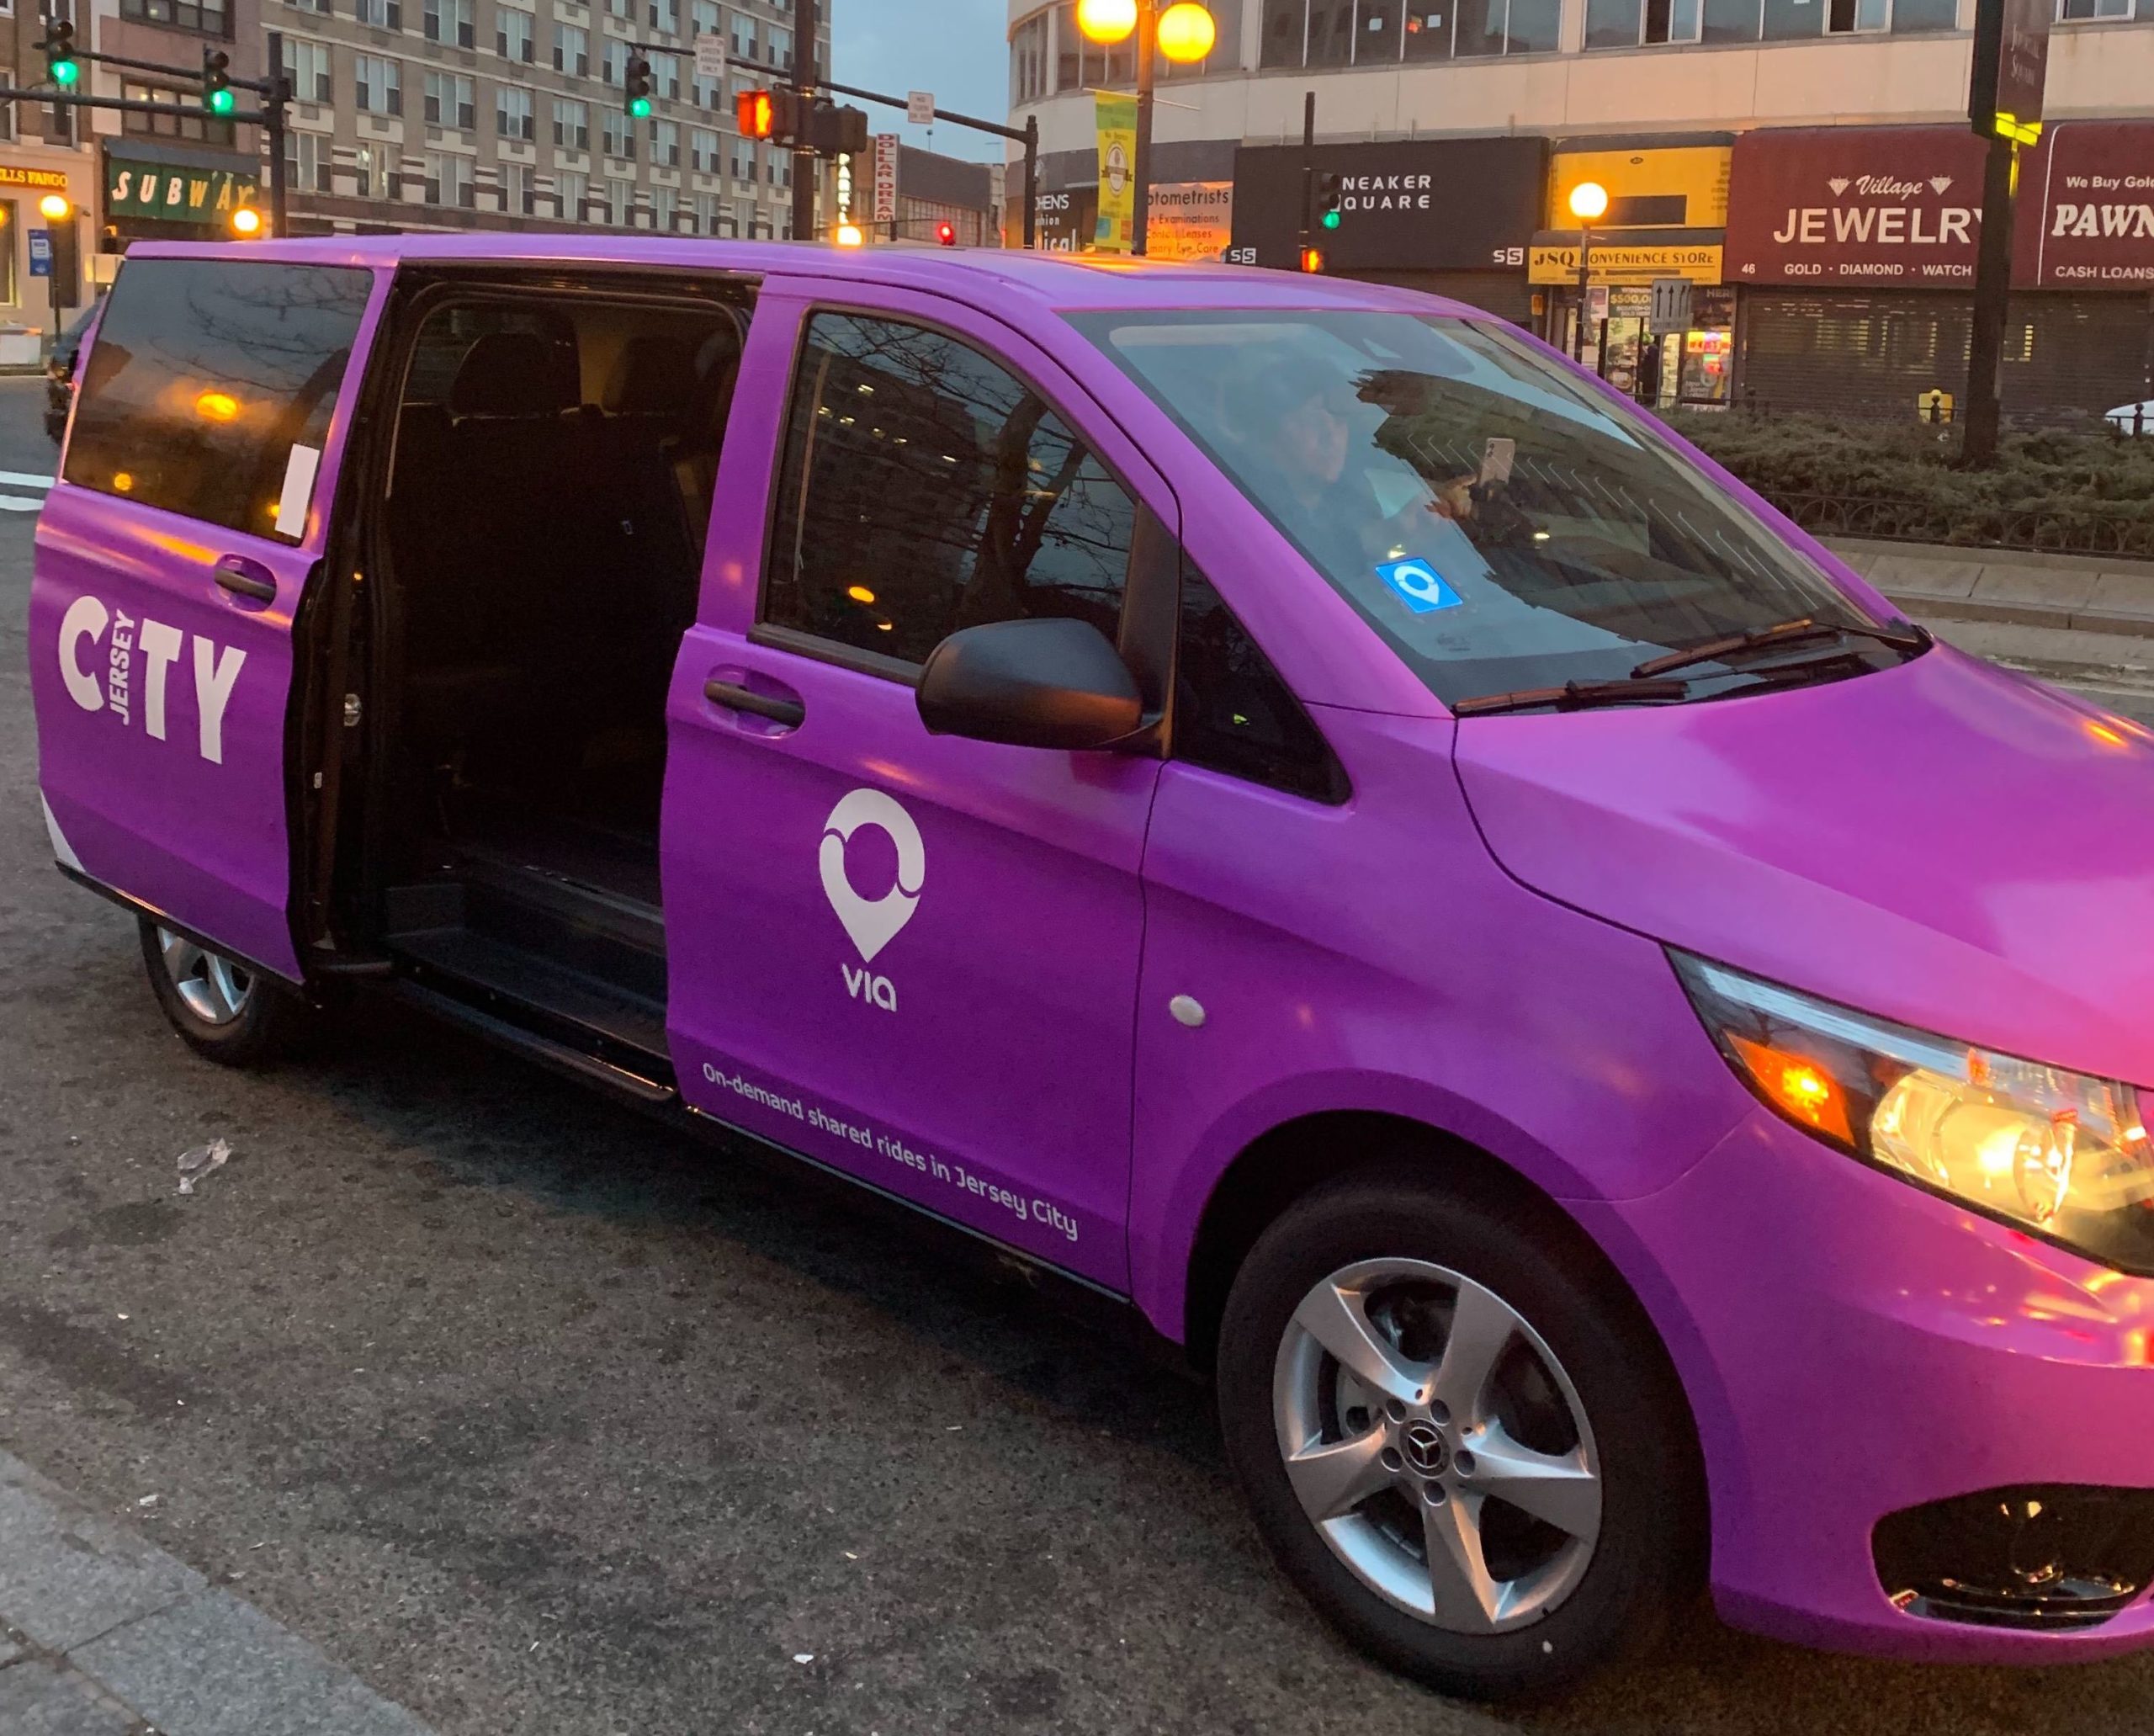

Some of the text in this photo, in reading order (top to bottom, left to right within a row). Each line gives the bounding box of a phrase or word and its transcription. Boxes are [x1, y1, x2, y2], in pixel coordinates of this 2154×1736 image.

[27, 171, 69, 187] FARGO
[877, 134, 896, 220] DOLLAR DREAM
[1341, 174, 1432, 191] NEAKER
[2066, 175, 2089, 188] We
[2092, 175, 2121, 192] Buy
[111, 171, 256, 210] SUBWAY
[1855, 174, 1923, 201] Village
[1148, 188, 1228, 206] ptometrists
[1330, 194, 1430, 212] QUARE
[1159, 212, 1219, 224] Examinations
[2051, 204, 2154, 237] PAWN
[1534, 251, 1714, 268] JSQ ONVENIENCE STORE
[1741, 263, 1756, 274] 46
[1784, 263, 1973, 277] GOLD DIAMOND WATCH
[2055, 265, 2154, 280] CASH LOANS
[1610, 293, 1652, 305] $500,0
[1706, 288, 1730, 299] HER
[109, 608, 135, 726] JERSEY
[703, 1062, 1079, 1242] On-demand shared rides in Jersey City
